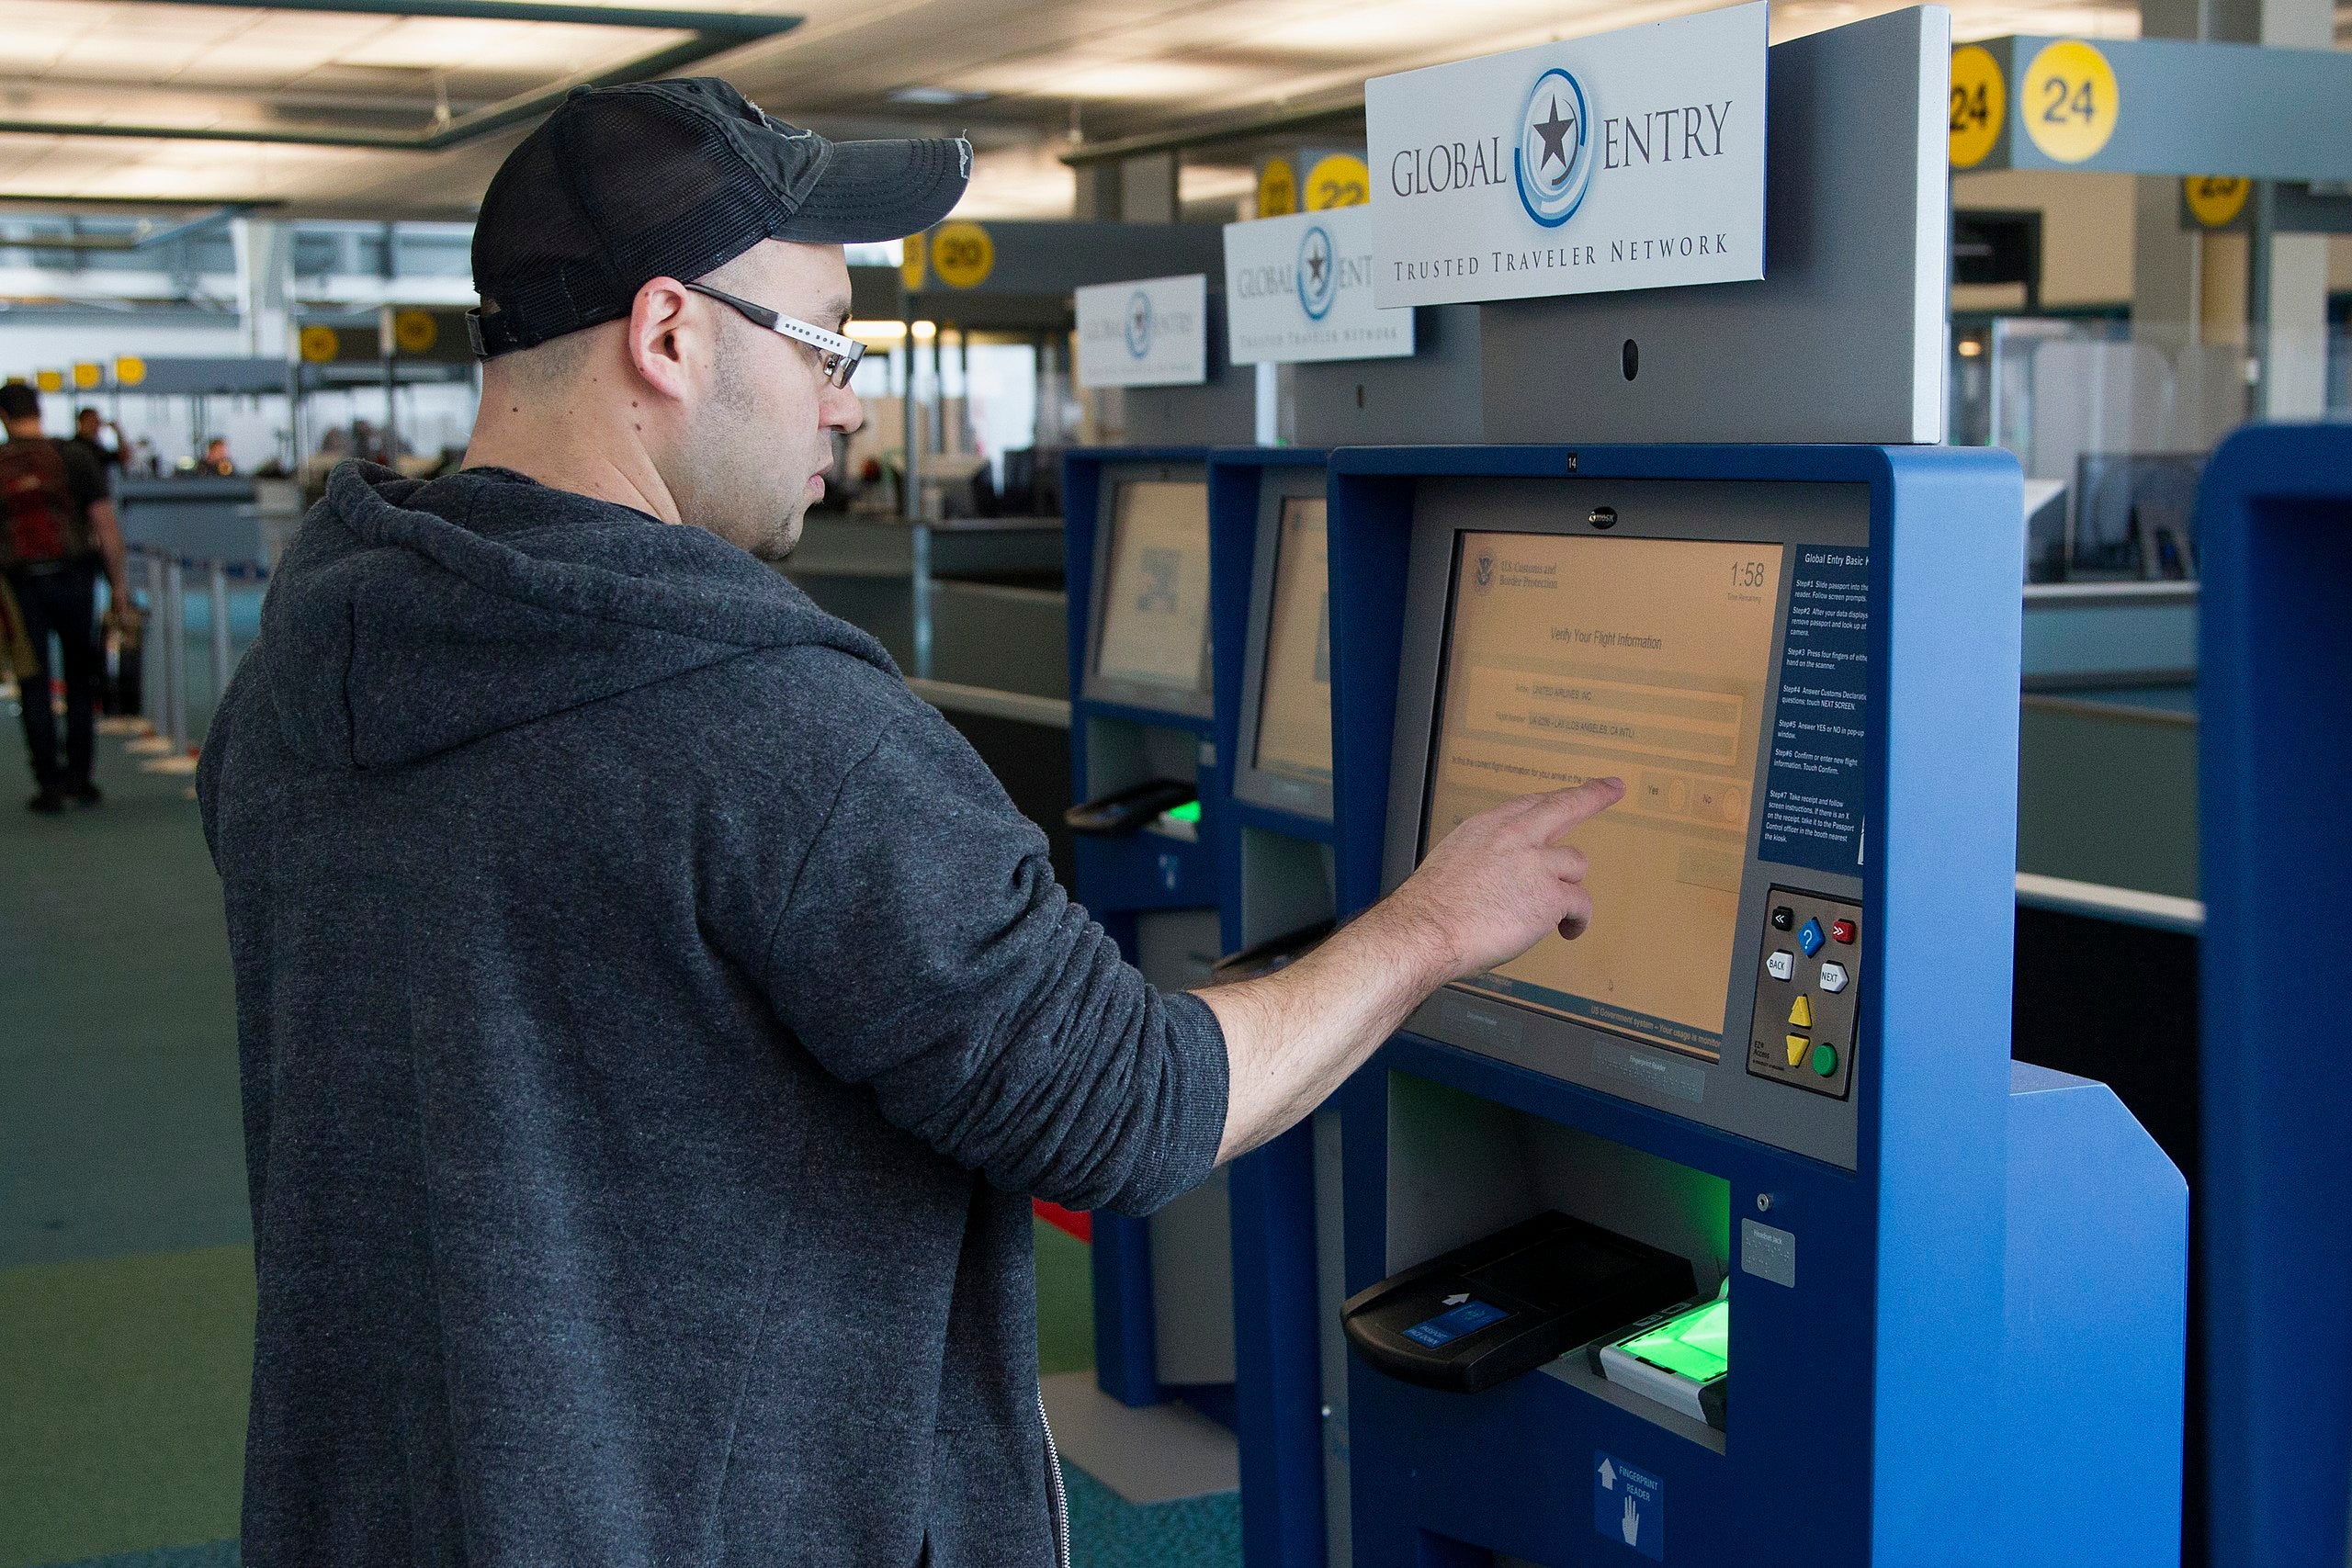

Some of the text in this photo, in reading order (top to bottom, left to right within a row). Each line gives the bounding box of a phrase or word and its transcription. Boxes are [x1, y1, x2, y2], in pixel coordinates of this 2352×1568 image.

[2042, 75, 2098, 125] 24
[1392, 100, 1733, 197] GLOBAL ENTRY
[1394, 232, 1728, 281] TRUSTED TRAVELER NETWORK
[1237, 254, 1374, 299] GLOBAL ENT
[1568, 457, 1577, 468] 14
[1805, 553, 1825, 563] Global
[1827, 555, 1844, 567] Entry
[1846, 556, 1863, 566] Basic
[1732, 561, 1764, 587] 1:58
[1796, 580, 1814, 588] Step#1
[1792, 606, 1810, 615] Step#2
[1551, 626, 1662, 649] Verify Your Flight Information
[1788, 648, 1805, 656] Step#3
[1807, 649, 1820, 658] Press
[1832, 652, 1849, 660] fingers
[1783, 685, 1867, 701] Step#4 Answer Customs Declaratio
[1821, 700, 1834, 708] NEXT
[1779, 719, 1796, 728] Step#5
[1798, 722, 1815, 730] Answer
[1817, 724, 1826, 732] YES
[1847, 729, 1864, 738] pop-up
[1775, 749, 1792, 757] Step#6
[1794, 751, 1813, 760] Confirm
[1845, 758, 1858, 767] flight
[1804, 763, 1817, 772] Touch
[1648, 784, 1658, 795] Yes
[1702, 794, 1712, 804] No
[1770, 790, 1787, 799] Step#7
[1789, 793, 1801, 801] Take
[1802, 795, 1817, 804] receipt
[1829, 799, 1843, 807] follow
[1766, 822, 1783, 831] Control
[1783, 825, 1799, 833] officer
[1814, 829, 1828, 839] booth
[1828, 833, 1848, 841] nearest
[1802, 817, 1812, 825] take
[1832, 822, 1855, 832] Passport
[1769, 959, 1785, 971] BACK
[1822, 971, 1838, 983] NEXT
[1600, 1008, 1633, 1024] Government
[1660, 1024, 1673, 1035] Your
[1673, 1030, 1690, 1041] usage
[1619, 1466, 1658, 1491] FINGERPRINT
[1626, 1483, 1651, 1502] READER
